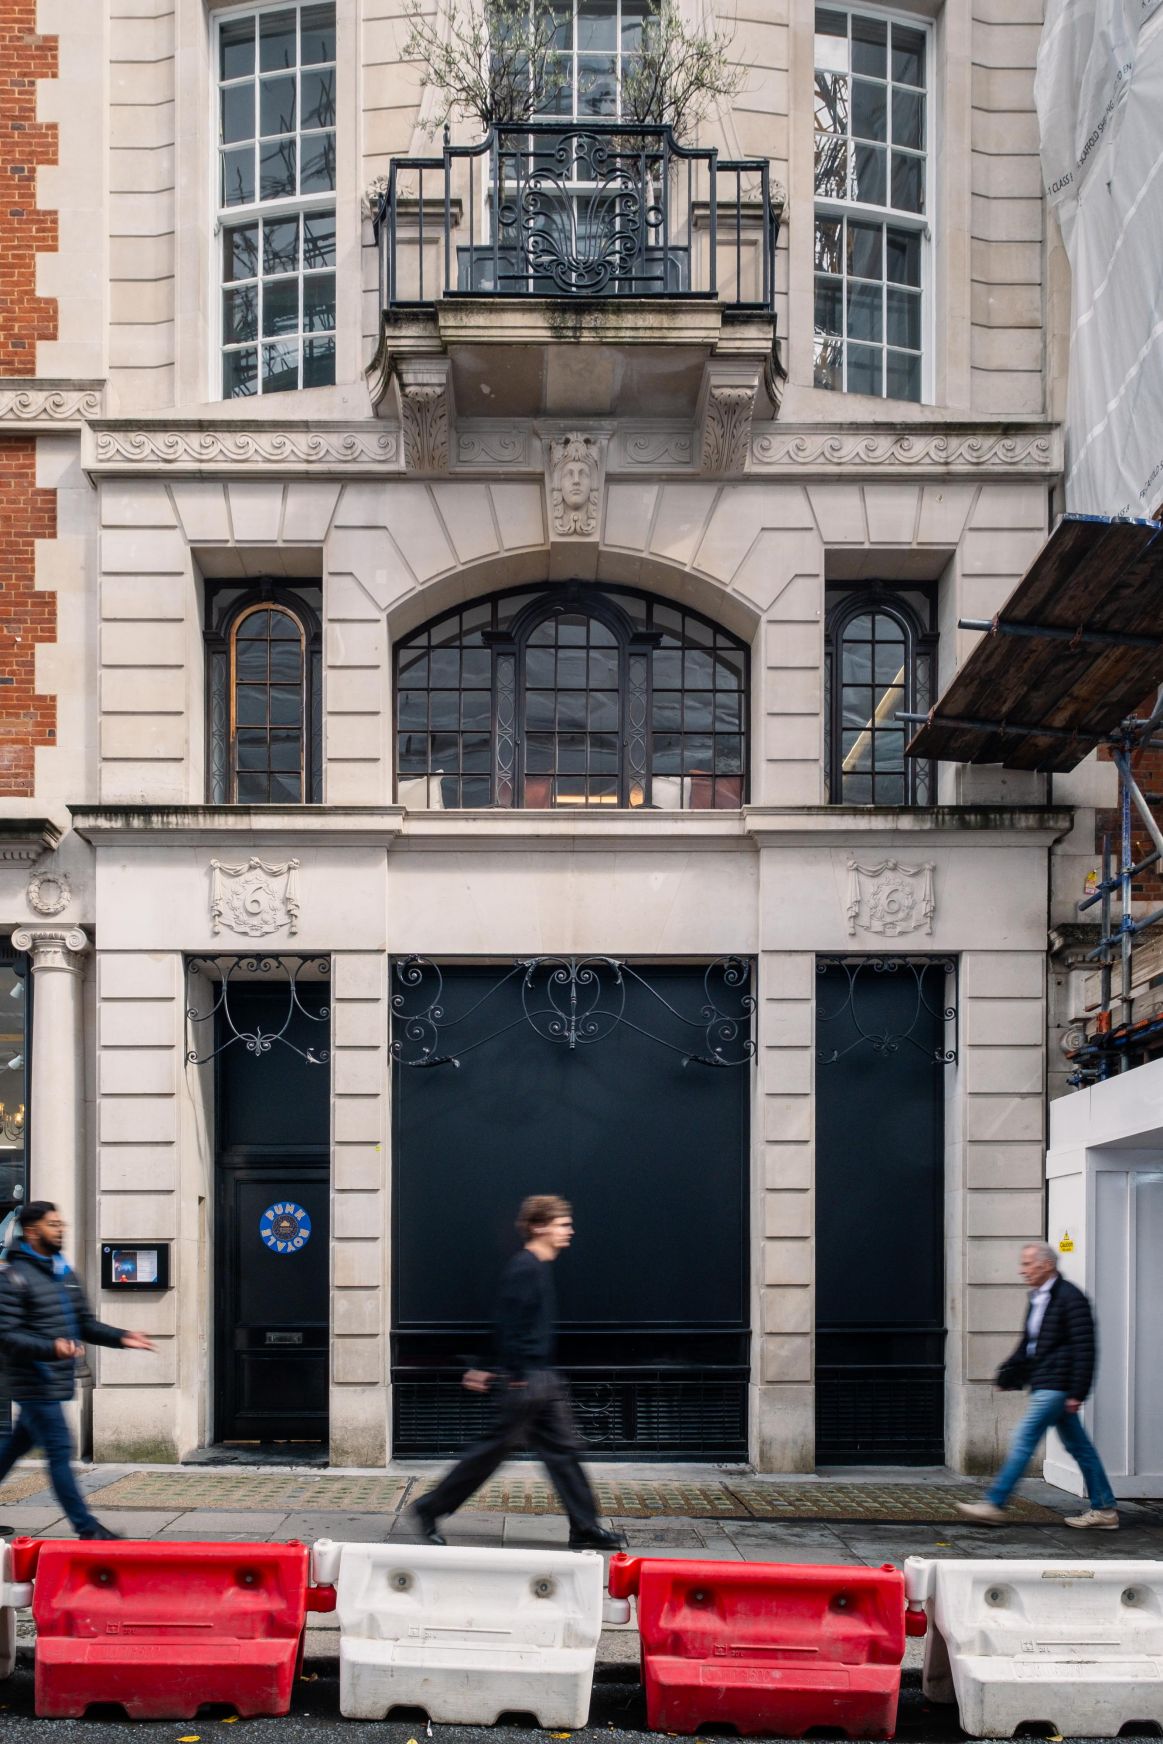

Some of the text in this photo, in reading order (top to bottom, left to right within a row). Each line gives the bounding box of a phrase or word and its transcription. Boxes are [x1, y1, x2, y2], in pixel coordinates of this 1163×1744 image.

[1052, 176, 1069, 193] CLASS
[245, 884, 263, 913] 6
[884, 886, 901, 912] 6
[265, 1203, 306, 1221] PUNK
[261, 1228, 310, 1252] ROYALE
